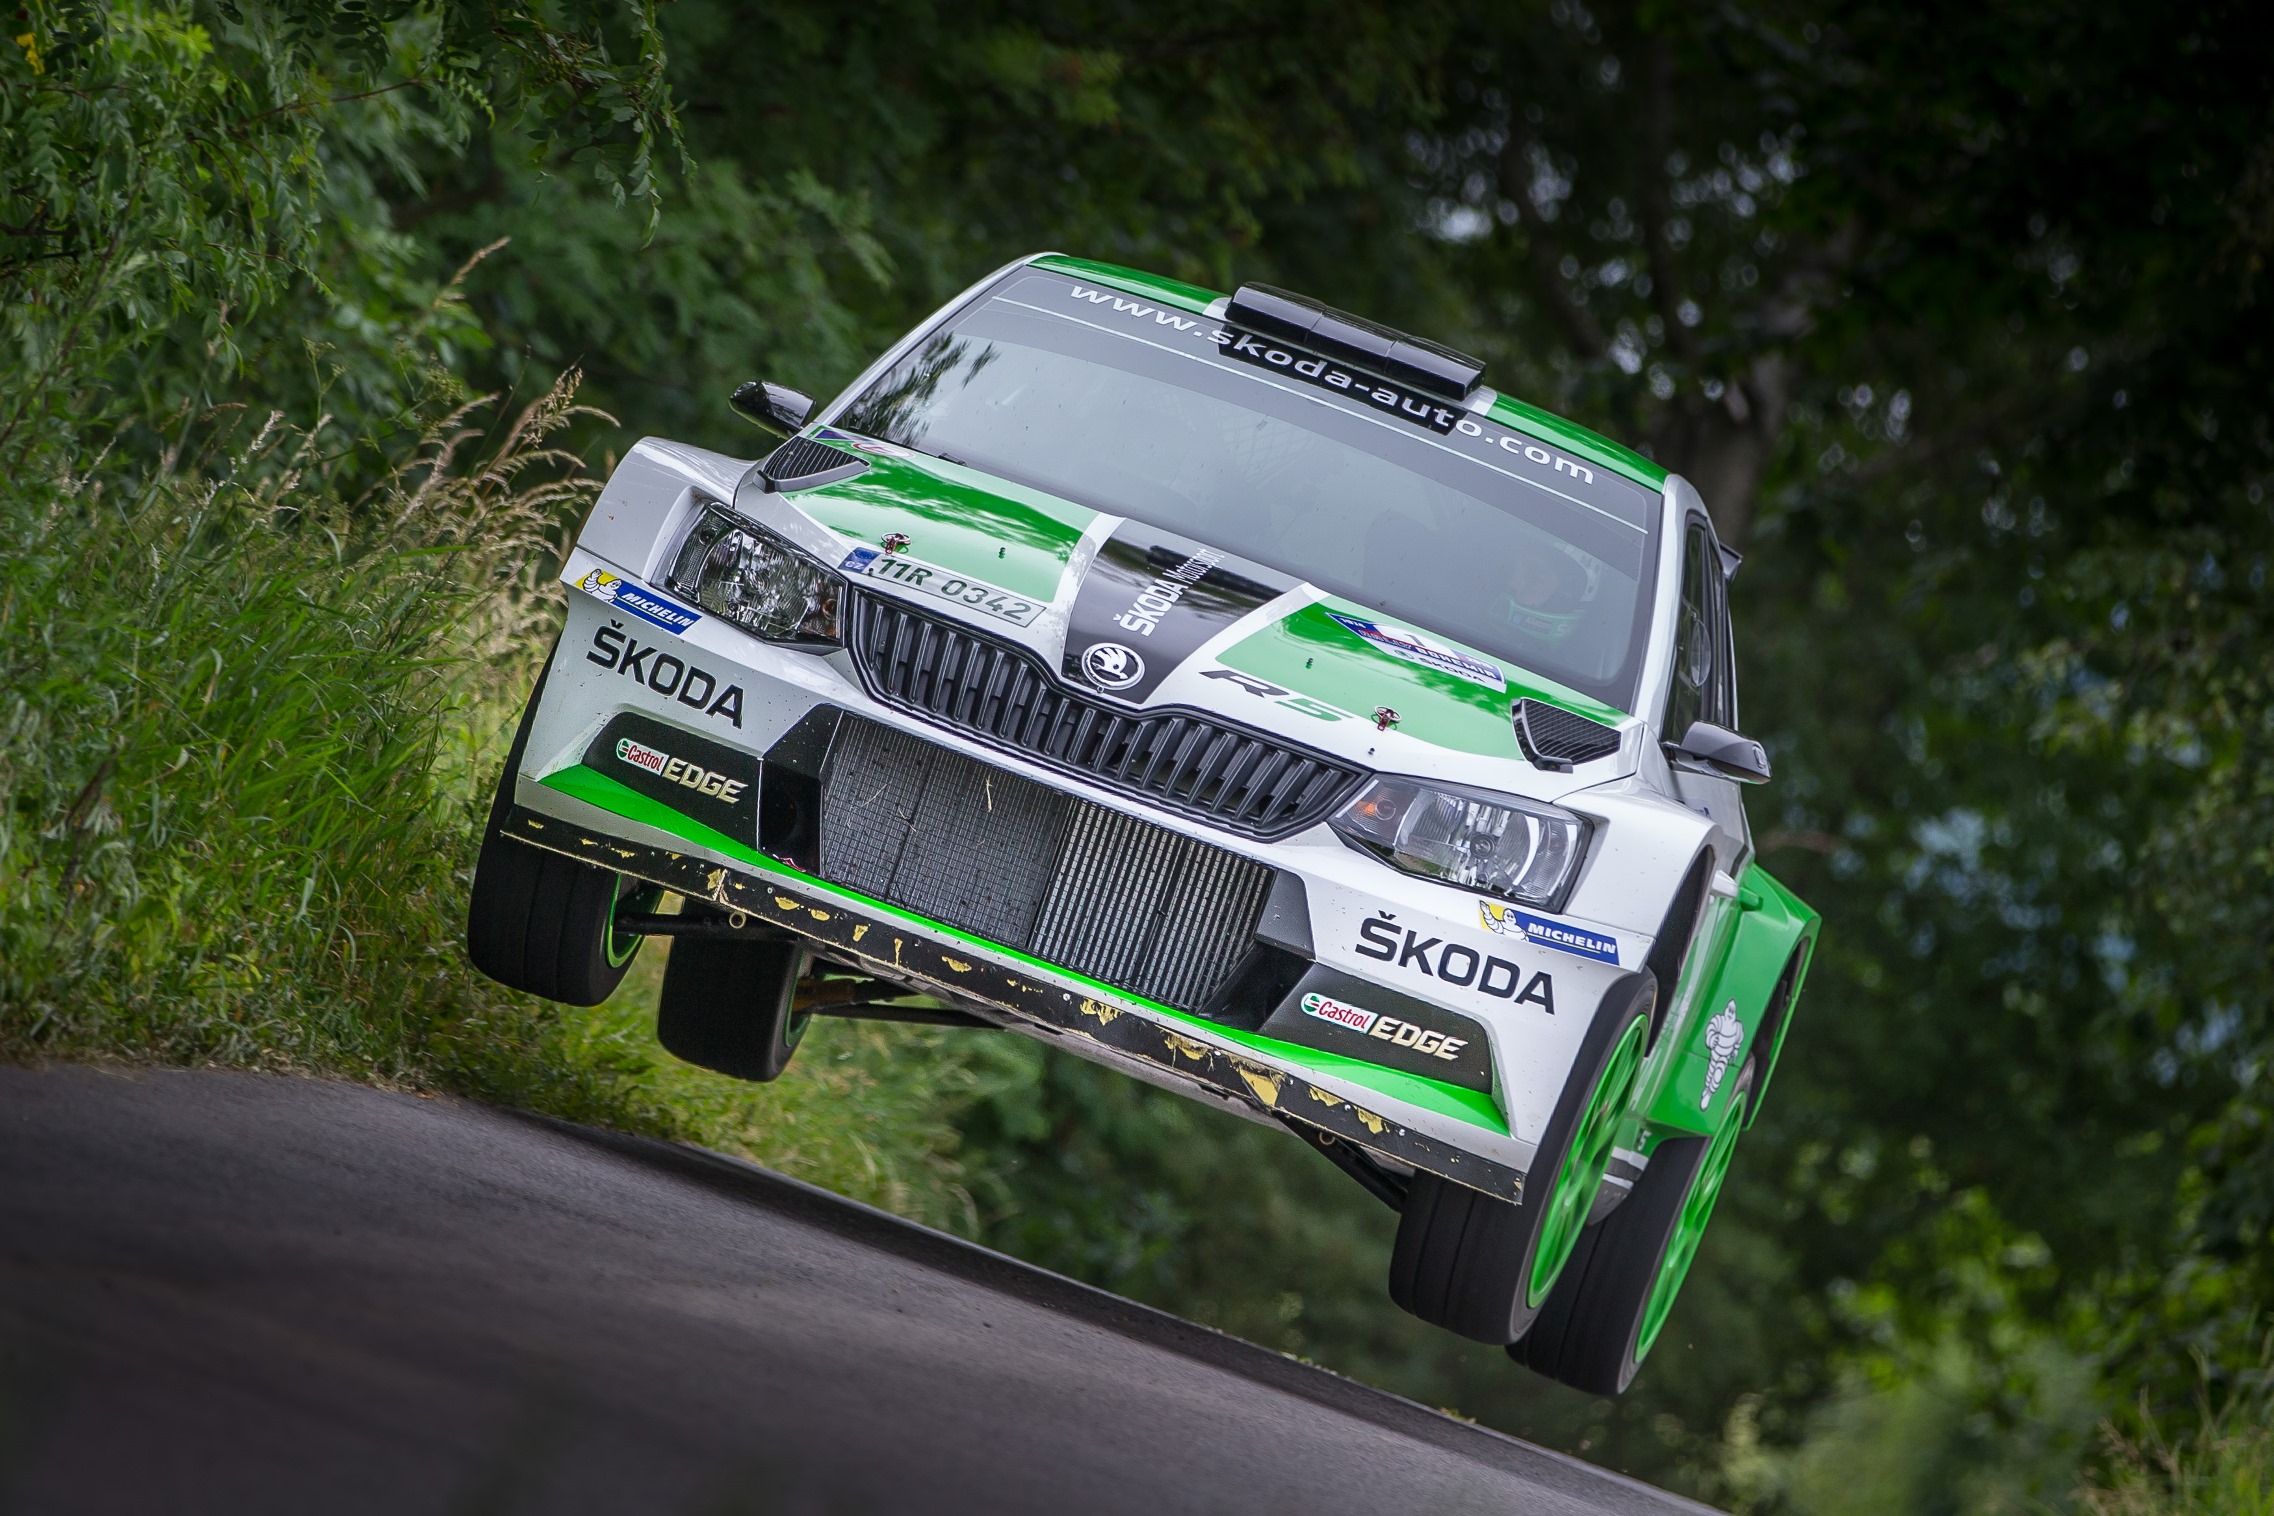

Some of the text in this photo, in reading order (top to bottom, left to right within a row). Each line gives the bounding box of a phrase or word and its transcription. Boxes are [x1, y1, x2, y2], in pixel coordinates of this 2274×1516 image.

[1069, 284, 1595, 485] www.skoda-auto.com
[844, 561, 865, 570] CZ
[878, 559, 1032, 621] 11R 0342
[1112, 547, 1225, 637] ŠKODA Motorsport
[622, 592, 694, 627] MICHELIN
[586, 619, 744, 729] ŠKODA
[627, 742, 748, 804] Castrol EDGE
[1355, 910, 1555, 1016] ŠKODA
[1527, 922, 1616, 955] MICHELIN
[1318, 1001, 1468, 1061] Castrol EDGE
